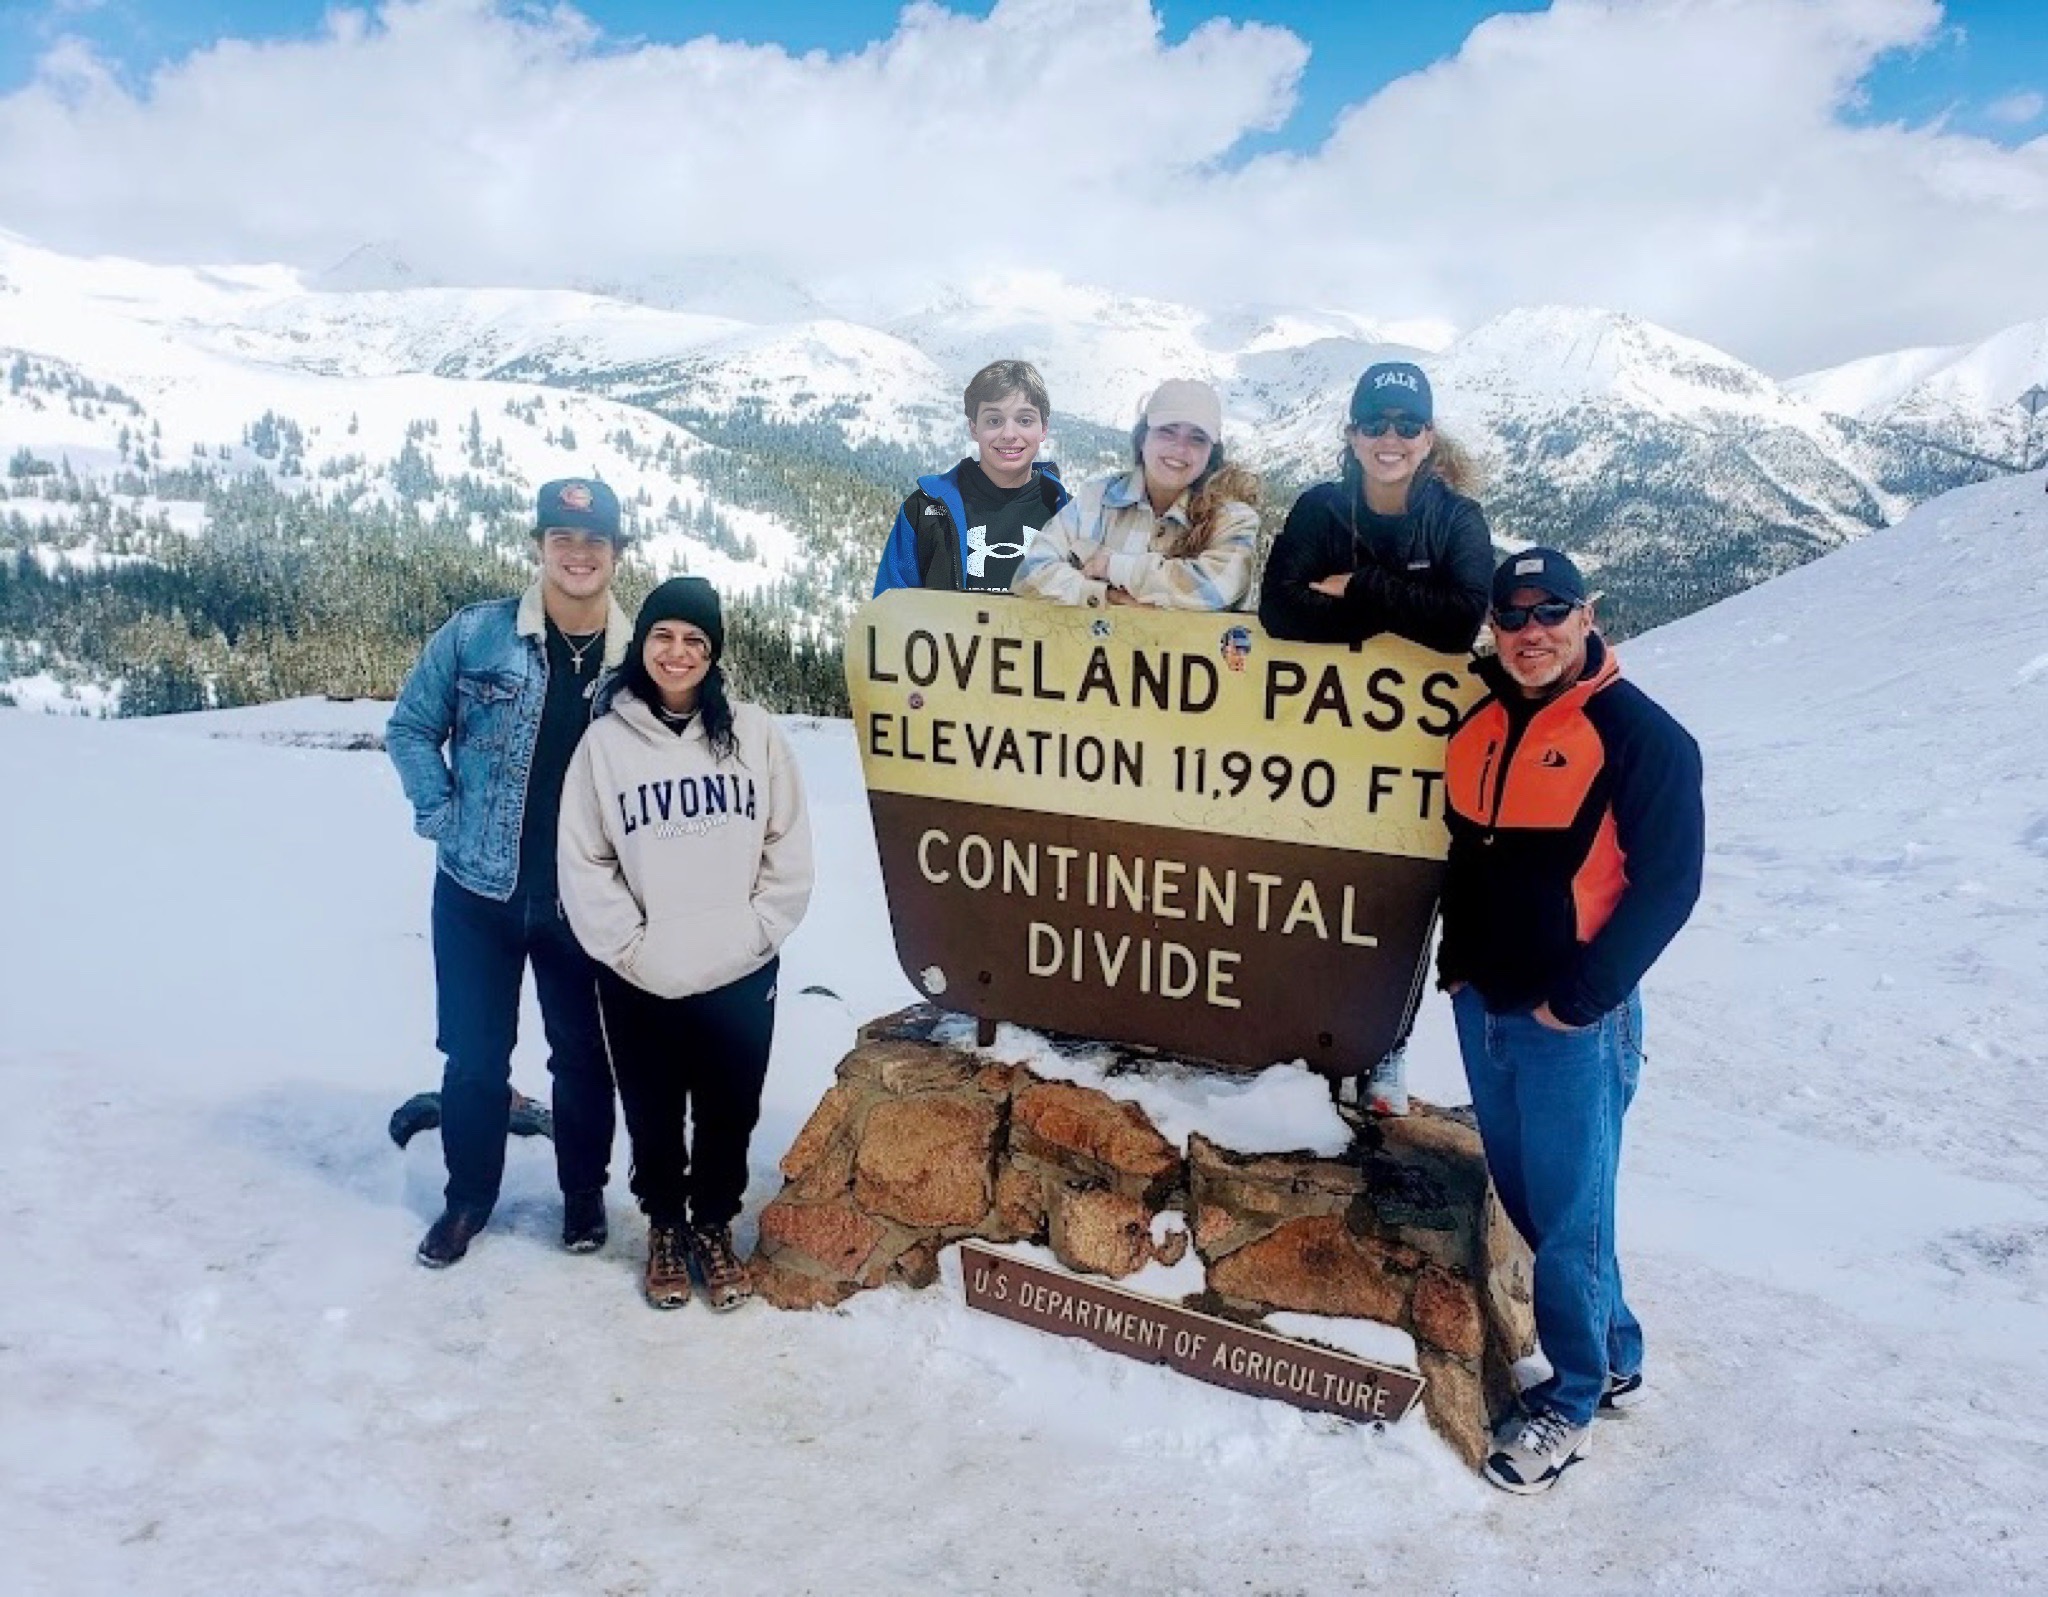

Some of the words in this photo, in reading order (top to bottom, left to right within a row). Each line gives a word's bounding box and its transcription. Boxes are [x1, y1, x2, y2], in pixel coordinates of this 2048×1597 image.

[867, 625, 1220, 712] LOVELAND
[1265, 660, 1459, 737] PASS
[618, 774, 756, 835] LIVONIA
[870, 713, 1143, 788] ELEVATION
[1174, 746, 1336, 808] 11,990
[1369, 766, 1444, 819] FT
[917, 829, 1378, 947] CONTINENTAL
[1028, 922, 1242, 1008] DIVIDE
[974, 1269, 1012, 1301] U.S.
[1019, 1282, 1169, 1351] DEPARTMENT
[1174, 1331, 1206, 1360] OF
[1212, 1341, 1391, 1418] AGRICULTURE
